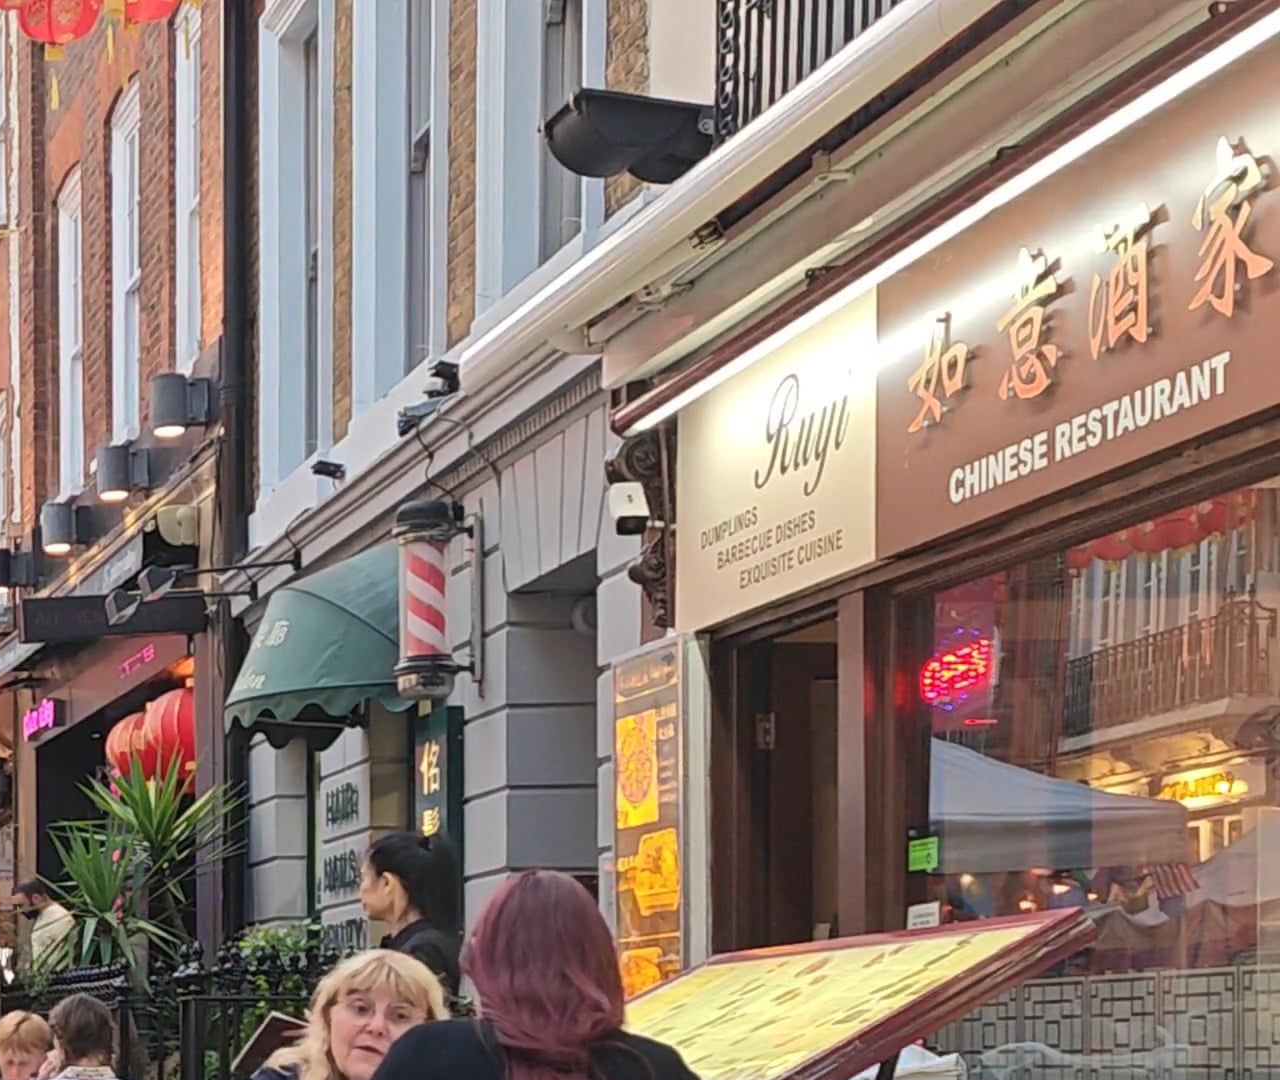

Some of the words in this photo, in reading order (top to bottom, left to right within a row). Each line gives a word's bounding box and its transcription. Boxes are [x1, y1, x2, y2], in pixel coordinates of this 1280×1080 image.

[754, 368, 851, 497] Ruyi
[948, 431, 1049, 503] CHINESE
[1054, 351, 1232, 462] RESTAURANT
[700, 505, 759, 550] DUMPLINGS
[716, 528, 773, 571] BARBECUE
[775, 510, 816, 545] DISHES
[739, 550, 795, 589] EXQUISITE
[796, 528, 844, 566] CUISINE
